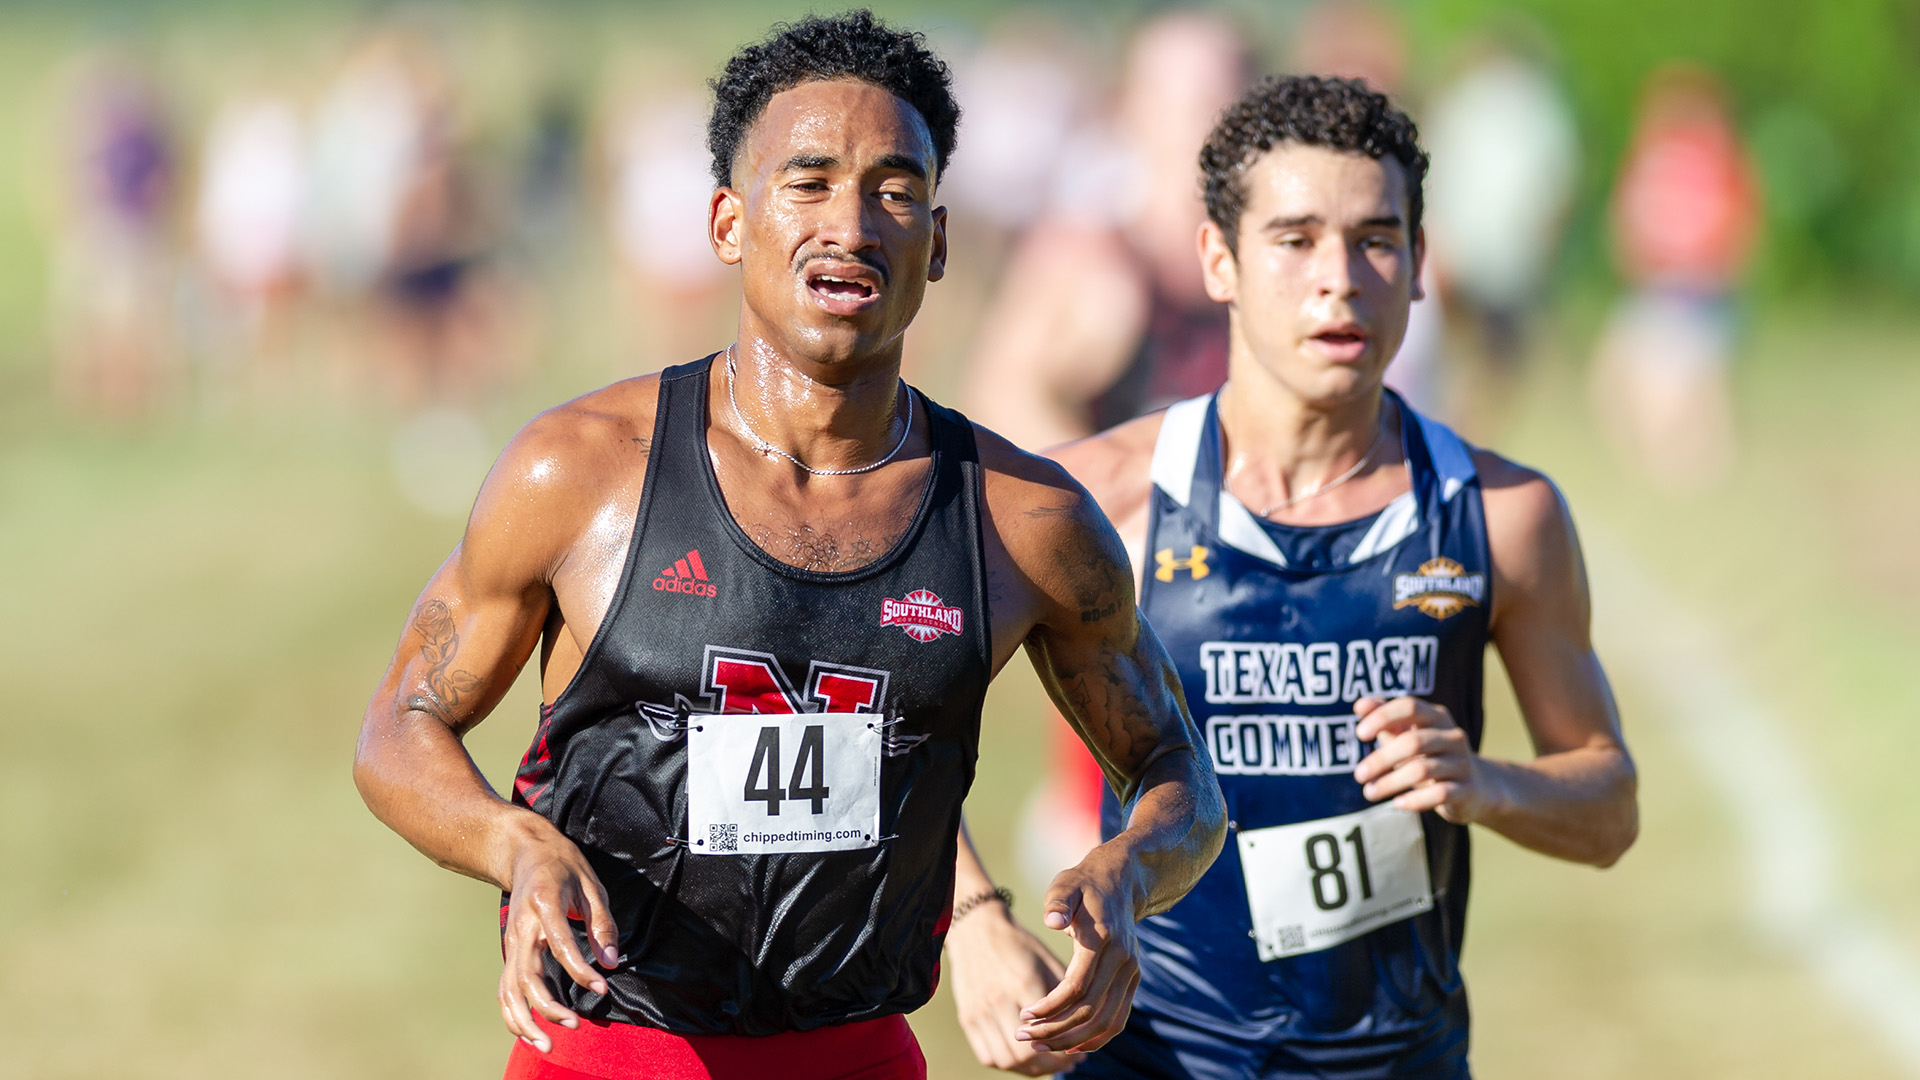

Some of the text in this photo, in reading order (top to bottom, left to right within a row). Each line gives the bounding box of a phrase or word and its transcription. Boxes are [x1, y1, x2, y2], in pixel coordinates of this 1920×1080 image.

[652, 576, 717, 597] adidas
[883, 600, 961, 632] SOUTHLAND
[1201, 636, 1438, 704] TEXAS A&M
[744, 725, 830, 816] 44
[1206, 715, 1374, 775] COMME
[743, 829, 861, 844] chippedtiming.com
[1305, 825, 1372, 910] 81
